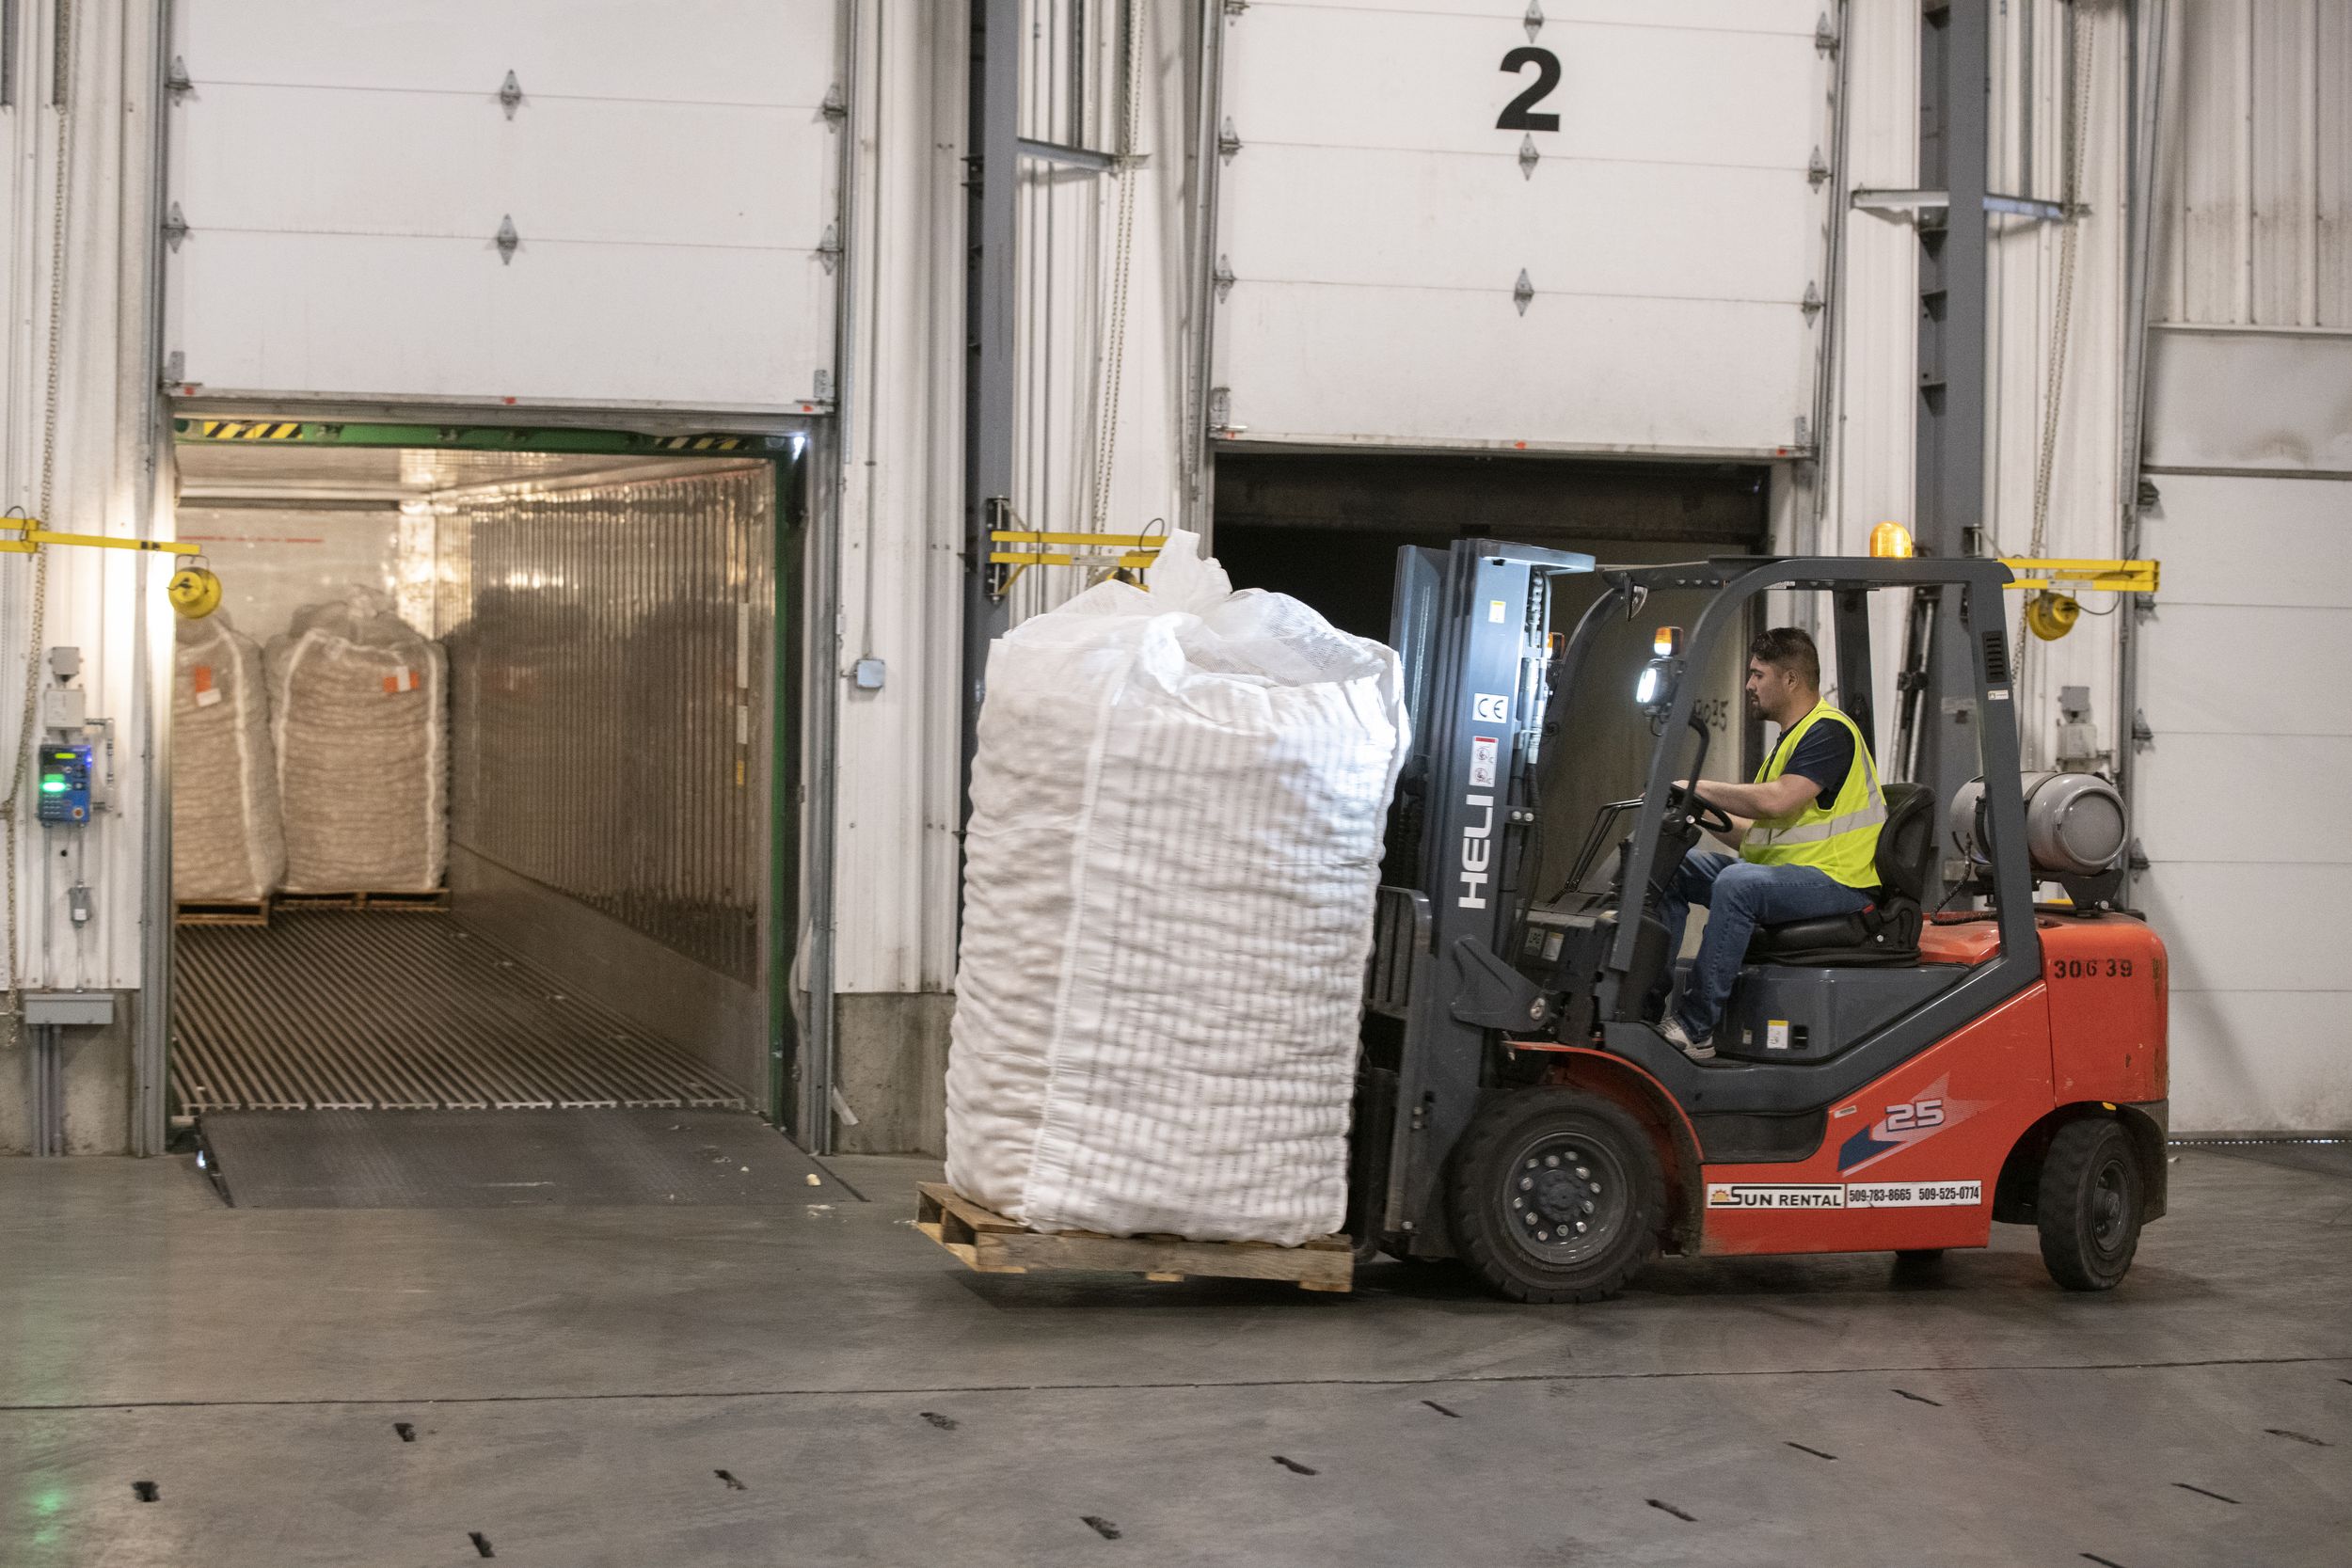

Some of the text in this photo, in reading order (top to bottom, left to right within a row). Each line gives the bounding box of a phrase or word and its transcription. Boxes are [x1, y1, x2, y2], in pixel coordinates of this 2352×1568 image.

[1496, 47, 1562, 132] 2
[1478, 698, 1504, 720] CE
[1459, 794, 1494, 910] HELI
[1885, 1100, 1946, 1132] 25
[1720, 1186, 1841, 1206] SUN RENTAL
[1849, 1186, 1979, 1202] 509-783-8665 509-525-0774
